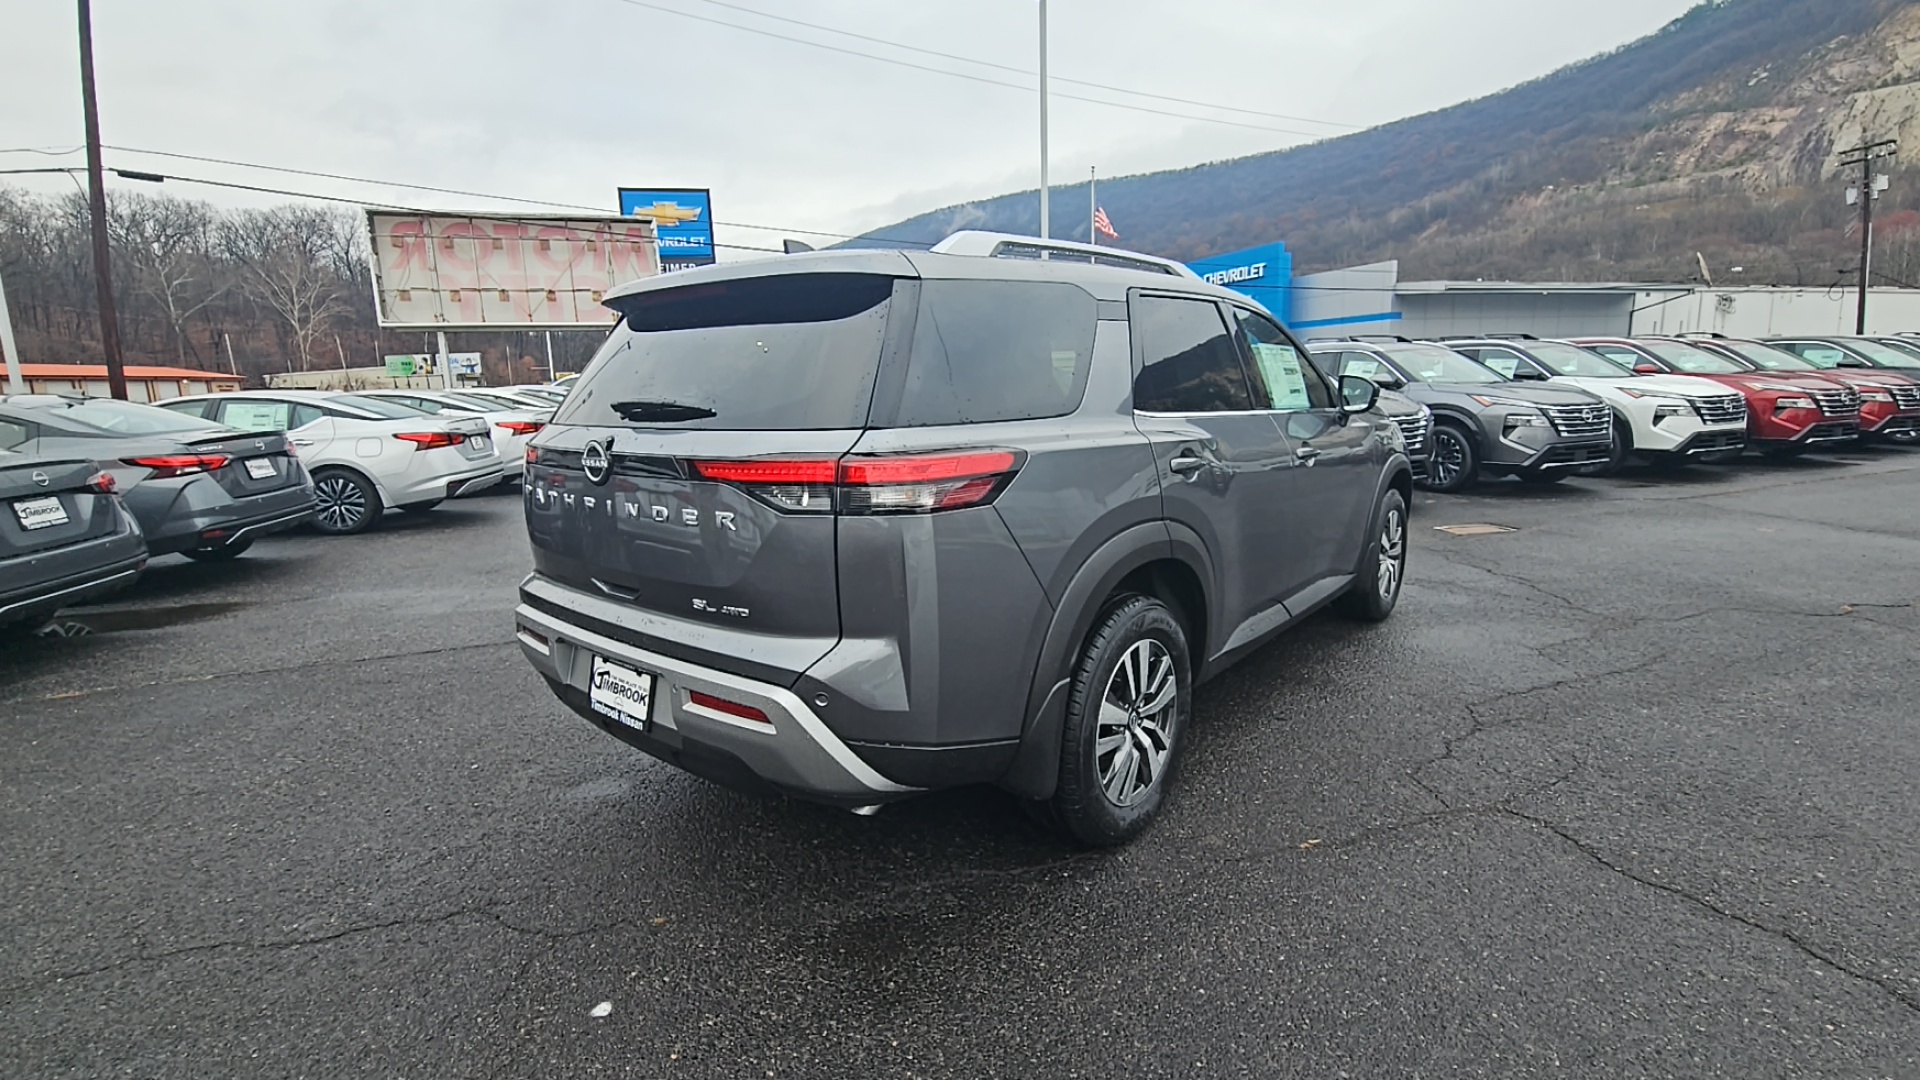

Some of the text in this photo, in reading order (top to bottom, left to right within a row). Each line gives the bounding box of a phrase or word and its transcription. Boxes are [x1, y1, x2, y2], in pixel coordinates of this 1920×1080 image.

[656, 236, 706, 248] VROLET
[1203, 262, 1268, 286] CHEVROLET
[525, 484, 737, 532] PATHFINDER
[692, 598, 717, 612] SL
[594, 668, 648, 705] TIMBROOK
[620, 711, 643, 731] Nissan
